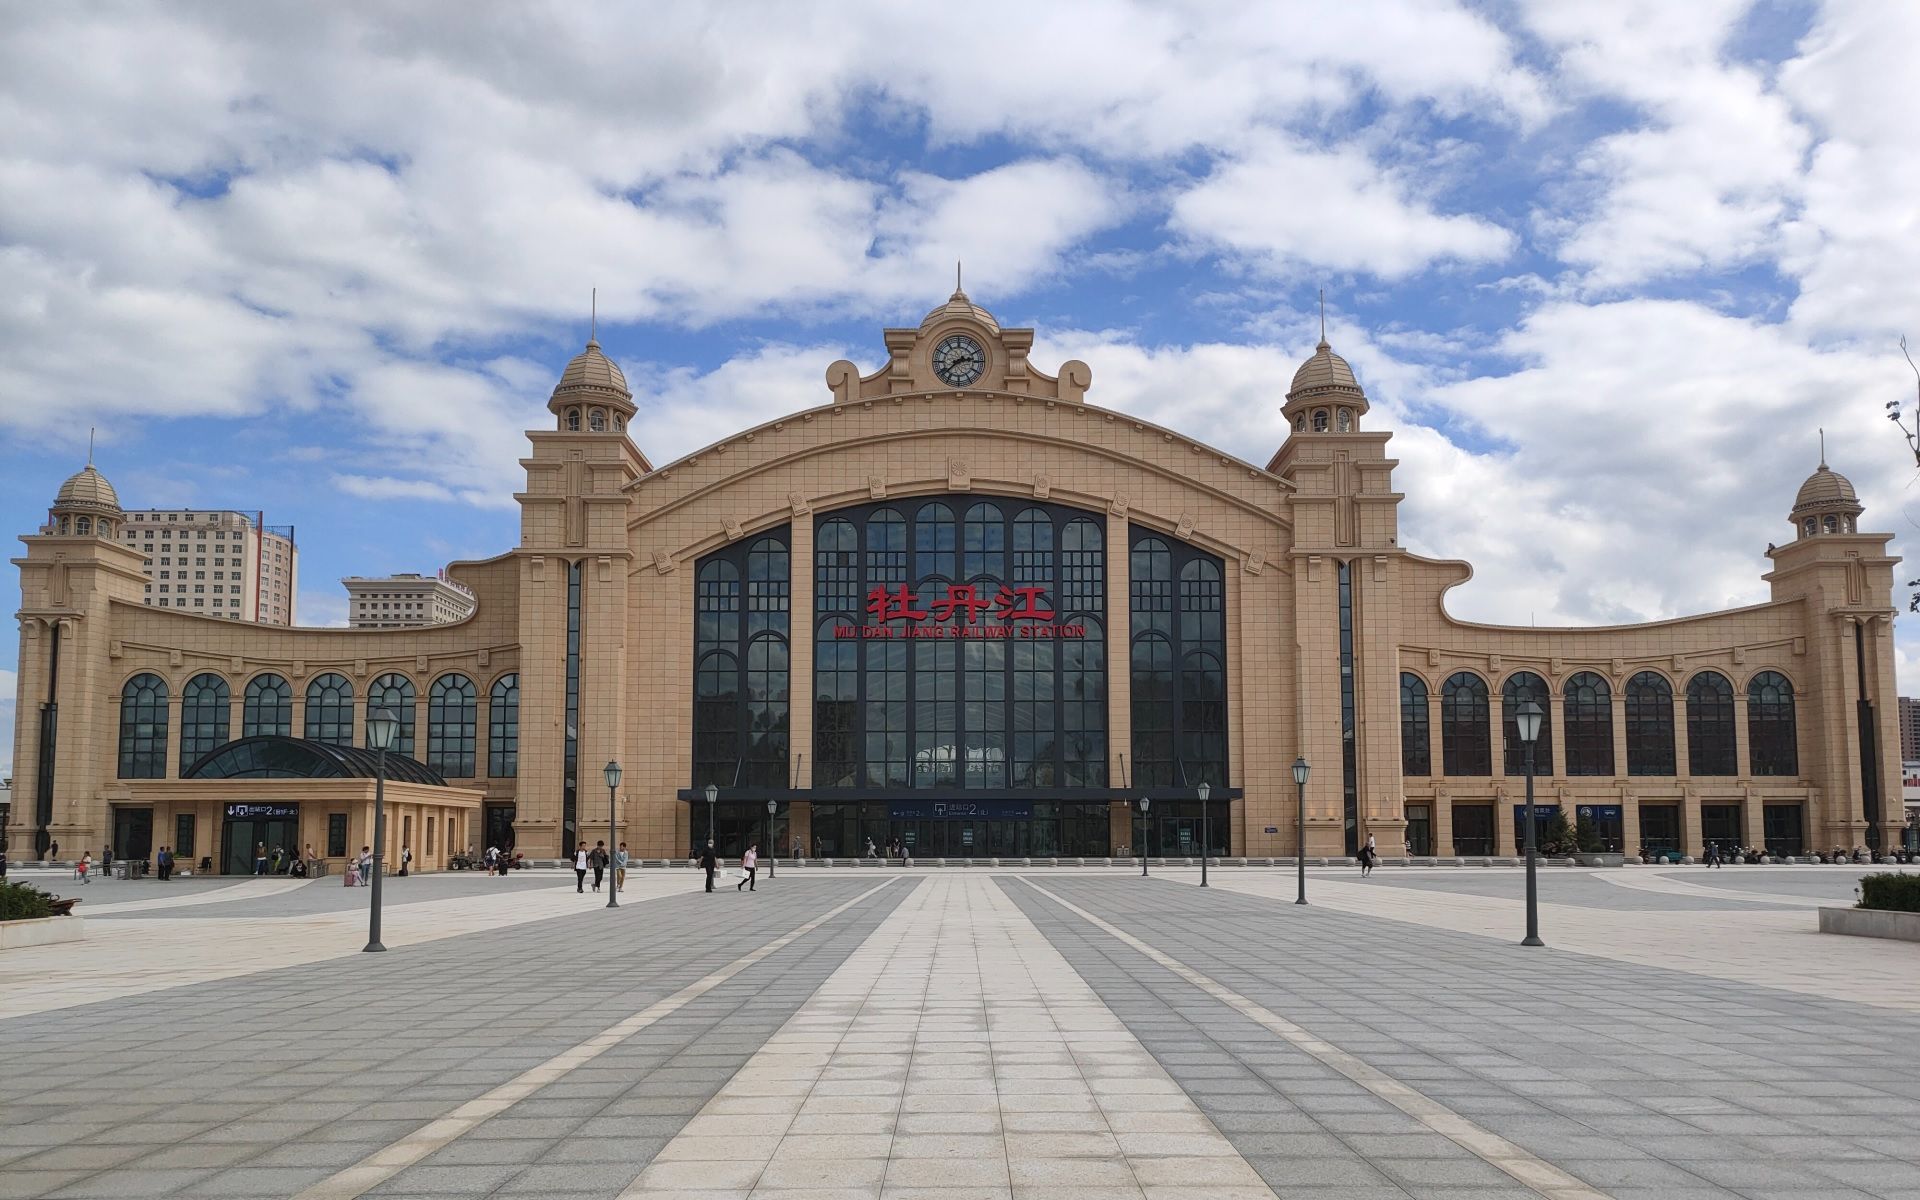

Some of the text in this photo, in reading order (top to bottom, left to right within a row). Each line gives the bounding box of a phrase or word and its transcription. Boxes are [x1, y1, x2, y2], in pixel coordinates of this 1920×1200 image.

[866, 583, 1056, 624] 牡丹江
[833, 625, 1086, 638] MU DAN JIANG RAILWAY STATION
[266, 806, 272, 815] 2
[969, 803, 977, 815] 2
